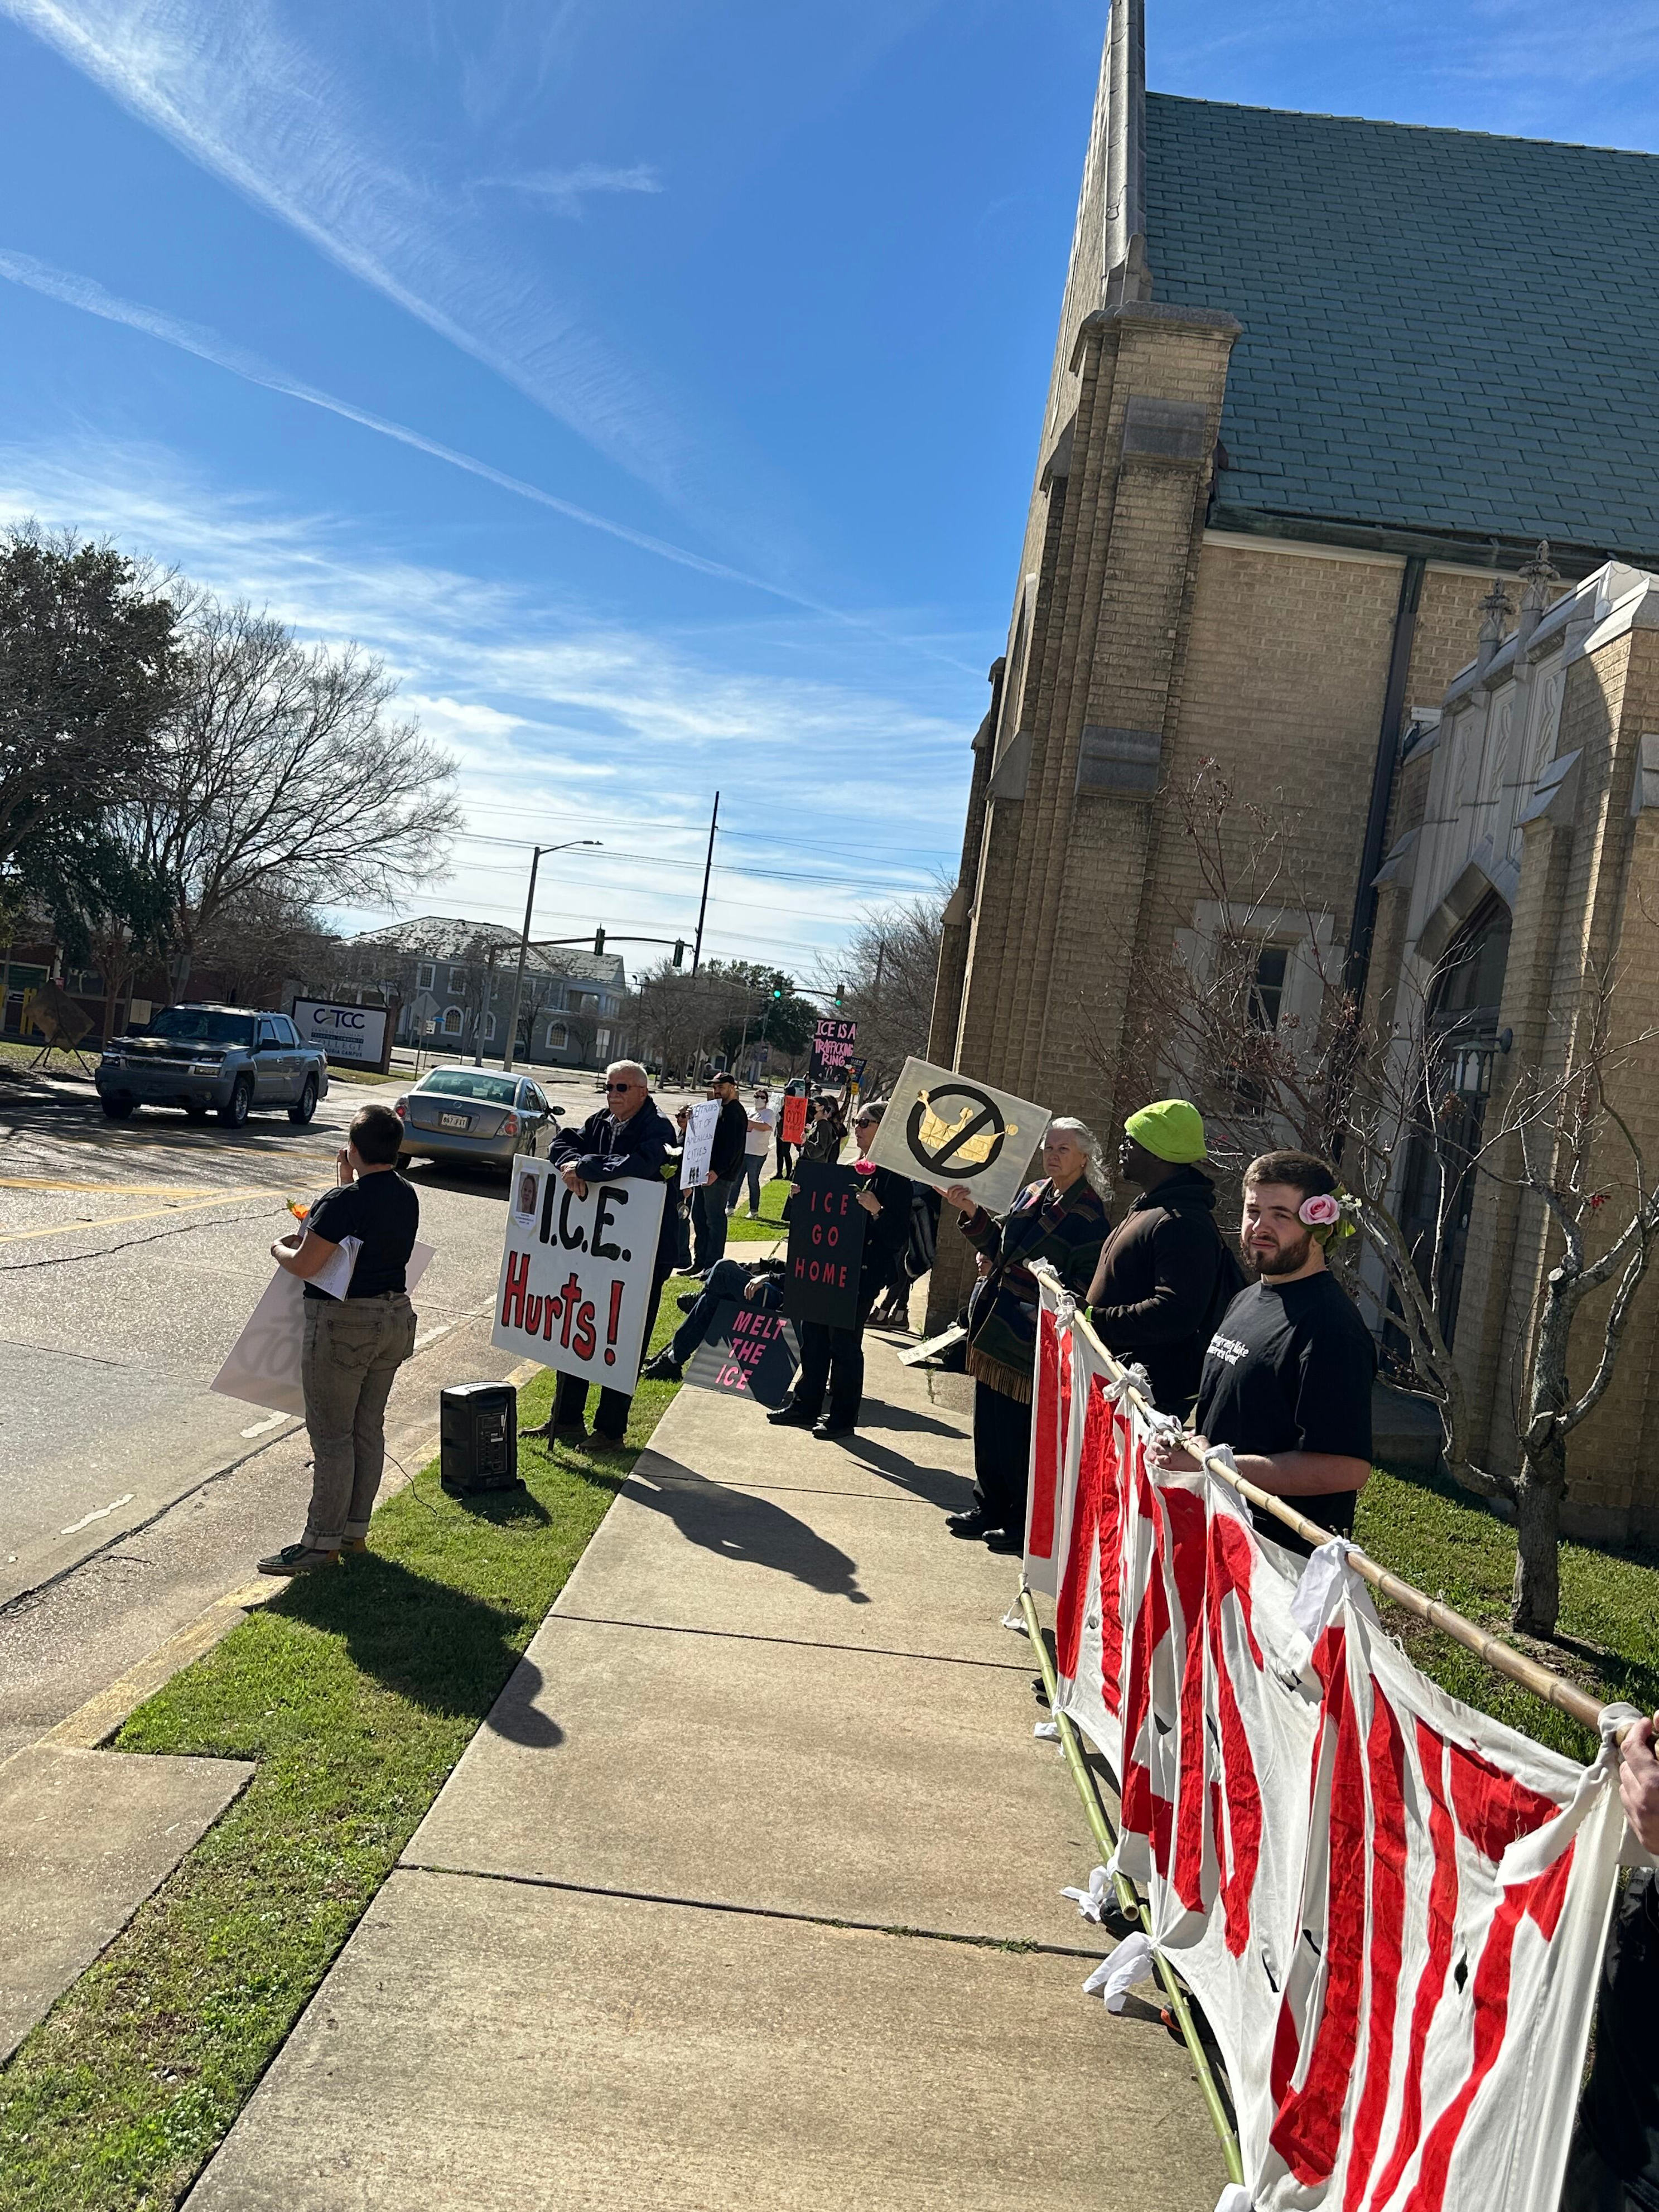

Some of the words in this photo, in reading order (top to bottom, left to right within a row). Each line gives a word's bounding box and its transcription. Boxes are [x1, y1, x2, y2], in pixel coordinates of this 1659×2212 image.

[816, 1020, 836, 1037] ICE
[837, 1023, 847, 1039] IS
[847, 1023, 856, 1040] A
[813, 1039, 853, 1057] TRAFFICKING
[821, 1052, 845, 1067] RING
[811, 1191, 848, 1215] ICE
[539, 1173, 631, 1262] I.C.E.
[812, 1224, 839, 1247] GO
[795, 1257, 847, 1288] HOME
[501, 1250, 625, 1366] Hurts!
[732, 1311, 787, 1340] MELT
[729, 1337, 766, 1365] THE
[715, 1364, 753, 1390] ICE
